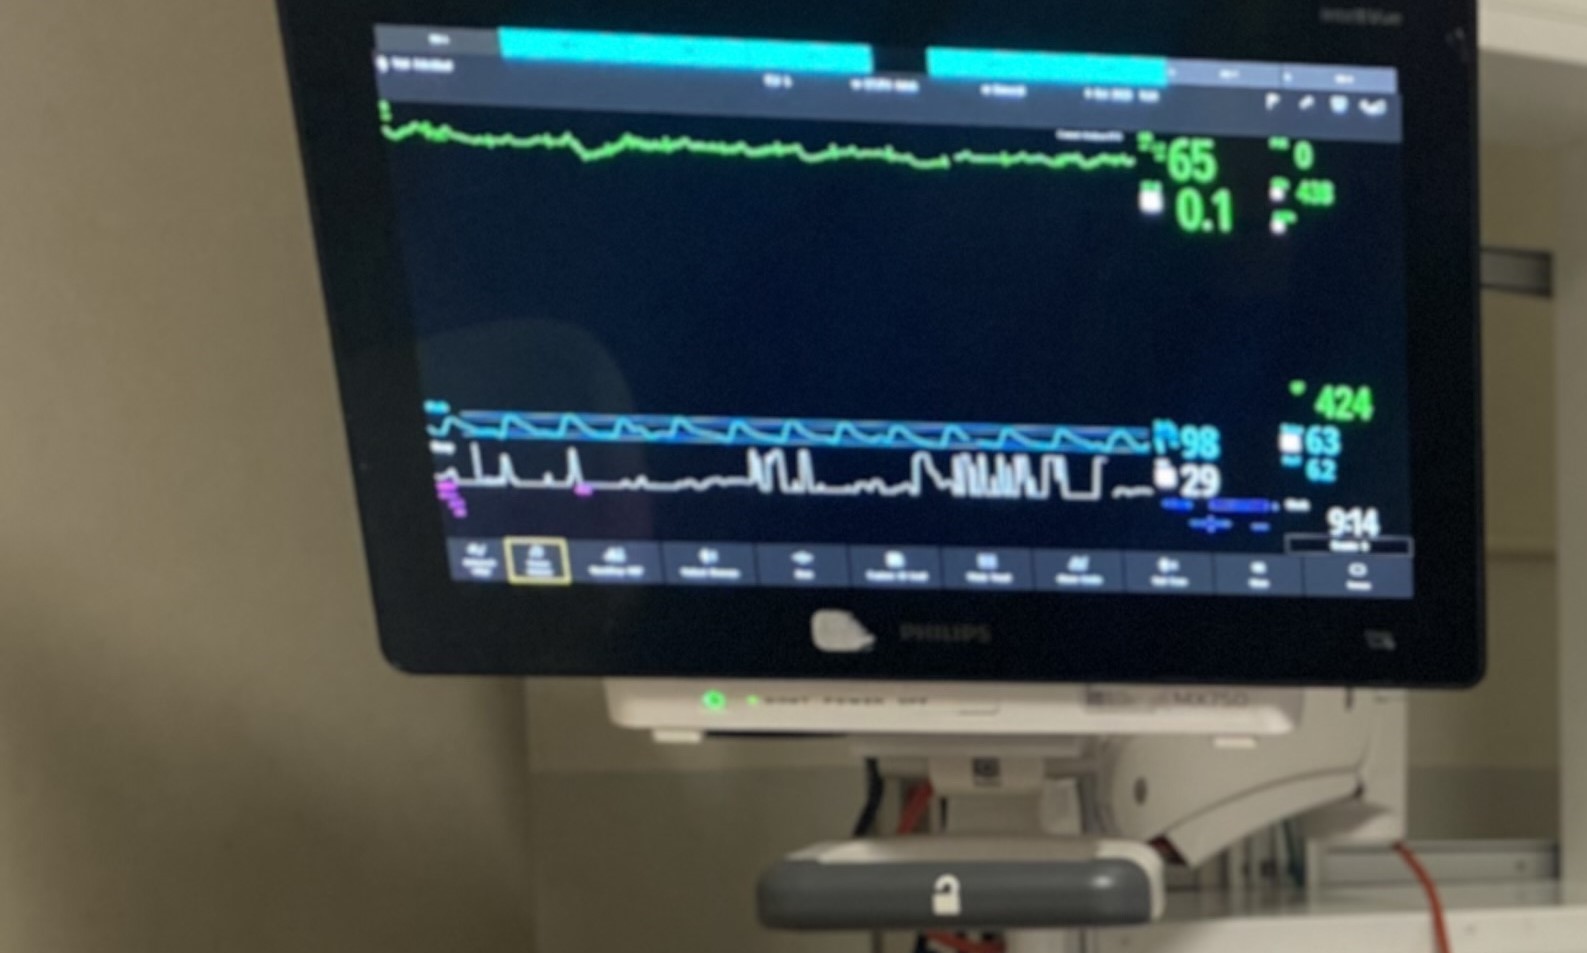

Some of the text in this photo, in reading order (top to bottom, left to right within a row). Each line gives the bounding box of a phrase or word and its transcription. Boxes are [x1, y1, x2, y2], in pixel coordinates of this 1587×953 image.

[1167, 136, 1218, 183] 65
[1293, 140, 1314, 170] 0
[1175, 186, 1233, 233] 0.1
[1314, 384, 1374, 422] 424
[1180, 424, 1222, 460] 98
[1305, 424, 1342, 456] 63
[1180, 463, 1222, 498] 29
[1305, 457, 1338, 482] 62
